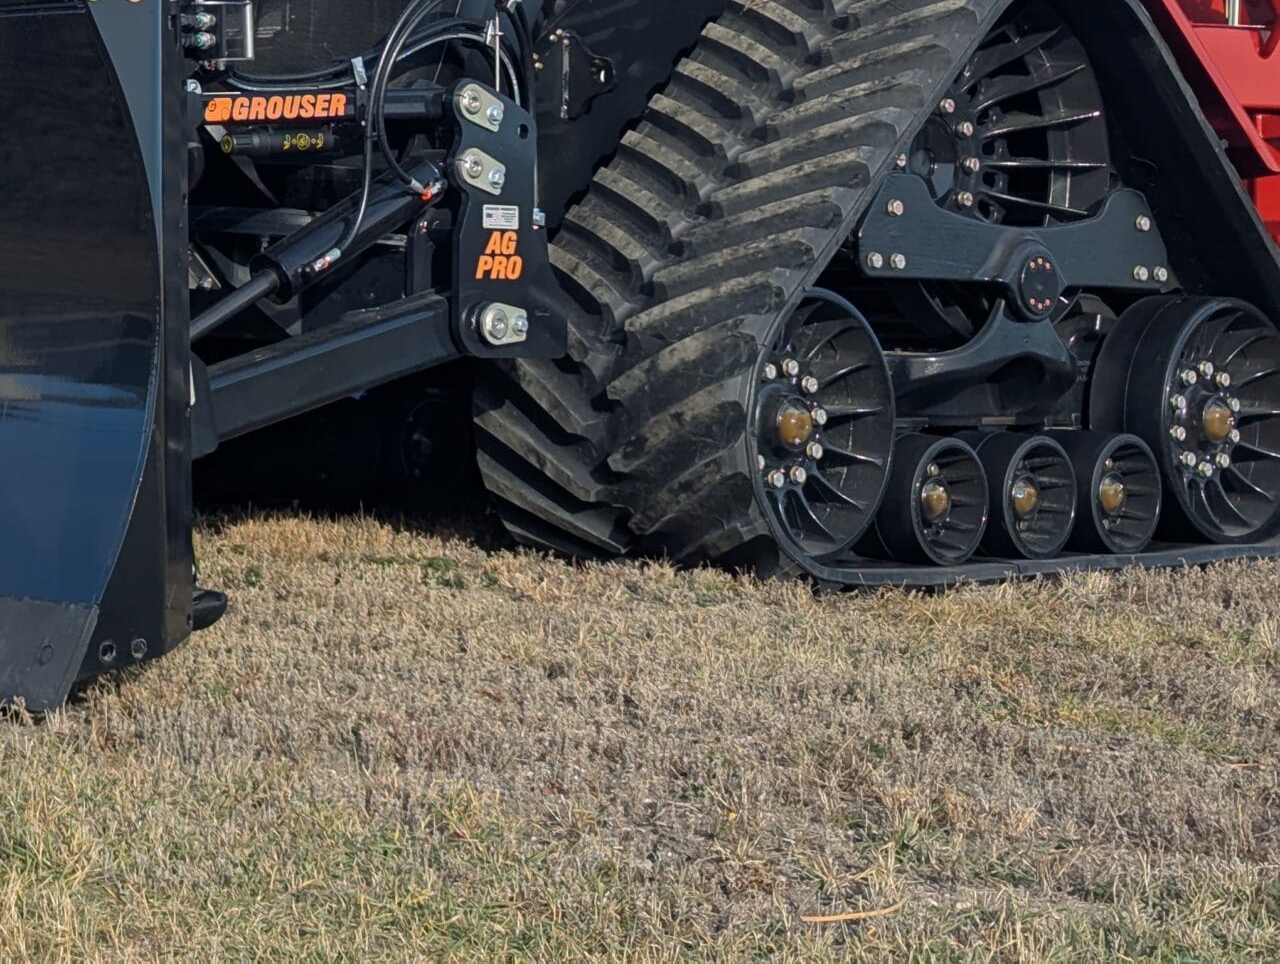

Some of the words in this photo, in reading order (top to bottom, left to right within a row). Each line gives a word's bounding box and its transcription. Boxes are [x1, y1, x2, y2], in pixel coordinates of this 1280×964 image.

[232, 93, 347, 121] GROUSER
[484, 231, 517, 255] AG
[475, 255, 522, 280] PRO
